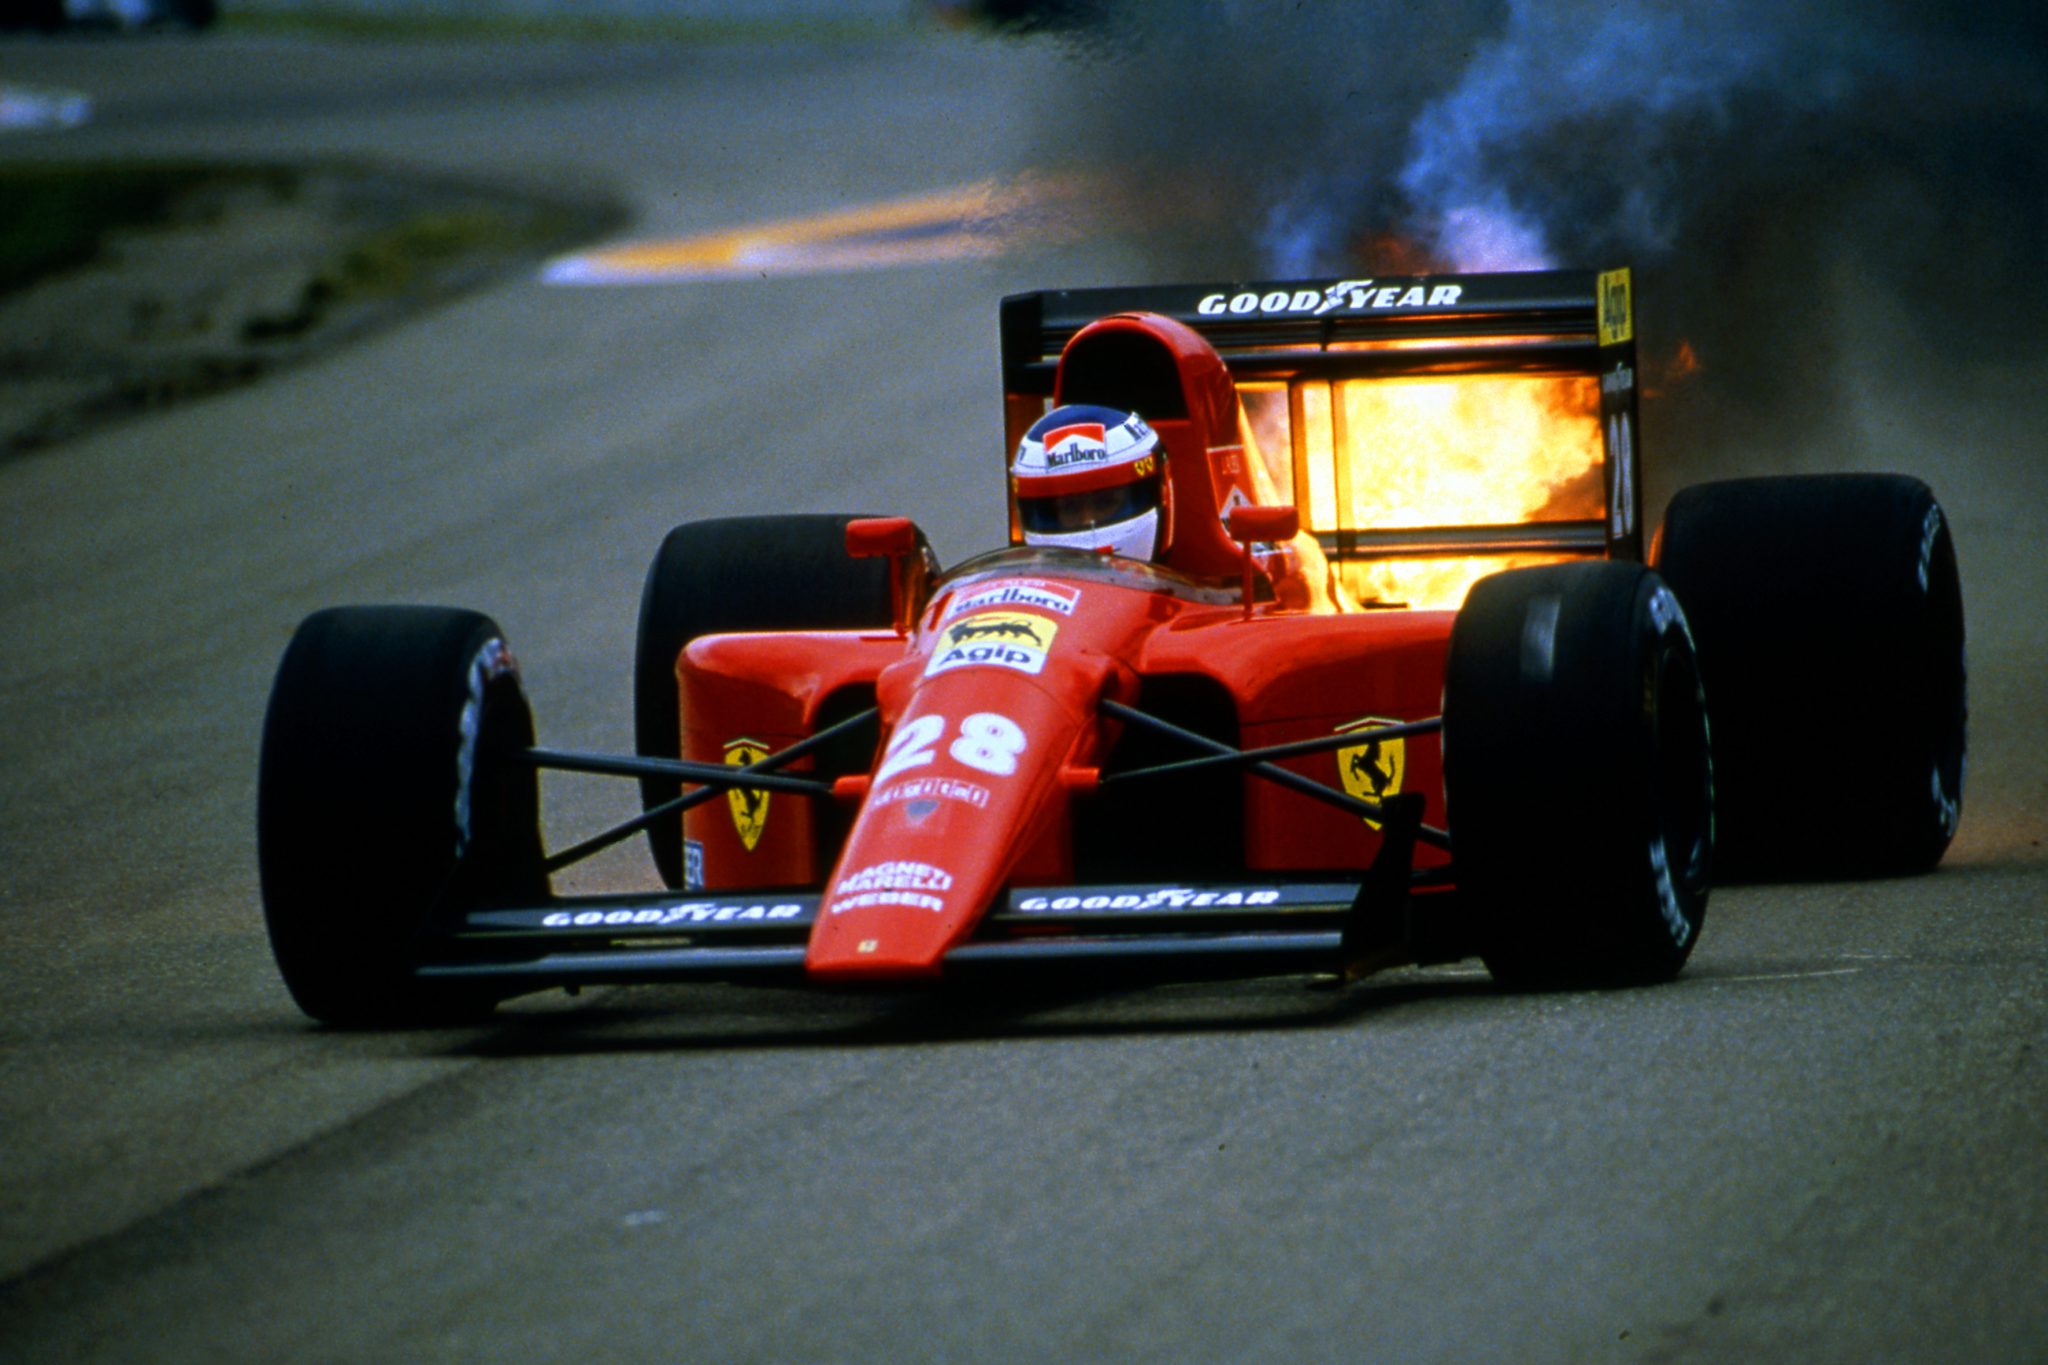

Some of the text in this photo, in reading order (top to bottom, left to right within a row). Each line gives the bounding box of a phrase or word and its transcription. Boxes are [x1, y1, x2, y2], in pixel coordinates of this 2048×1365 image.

[1198, 281, 1462, 315] GOODYEAR
[1048, 442, 1106, 466] Marlboro
[955, 588, 1070, 612] Marlboro
[939, 643, 1031, 666] Agip
[872, 712, 1028, 790] 28
[1019, 889, 1279, 910] GOODYEAR
[542, 902, 801, 927] GOODYEAR
